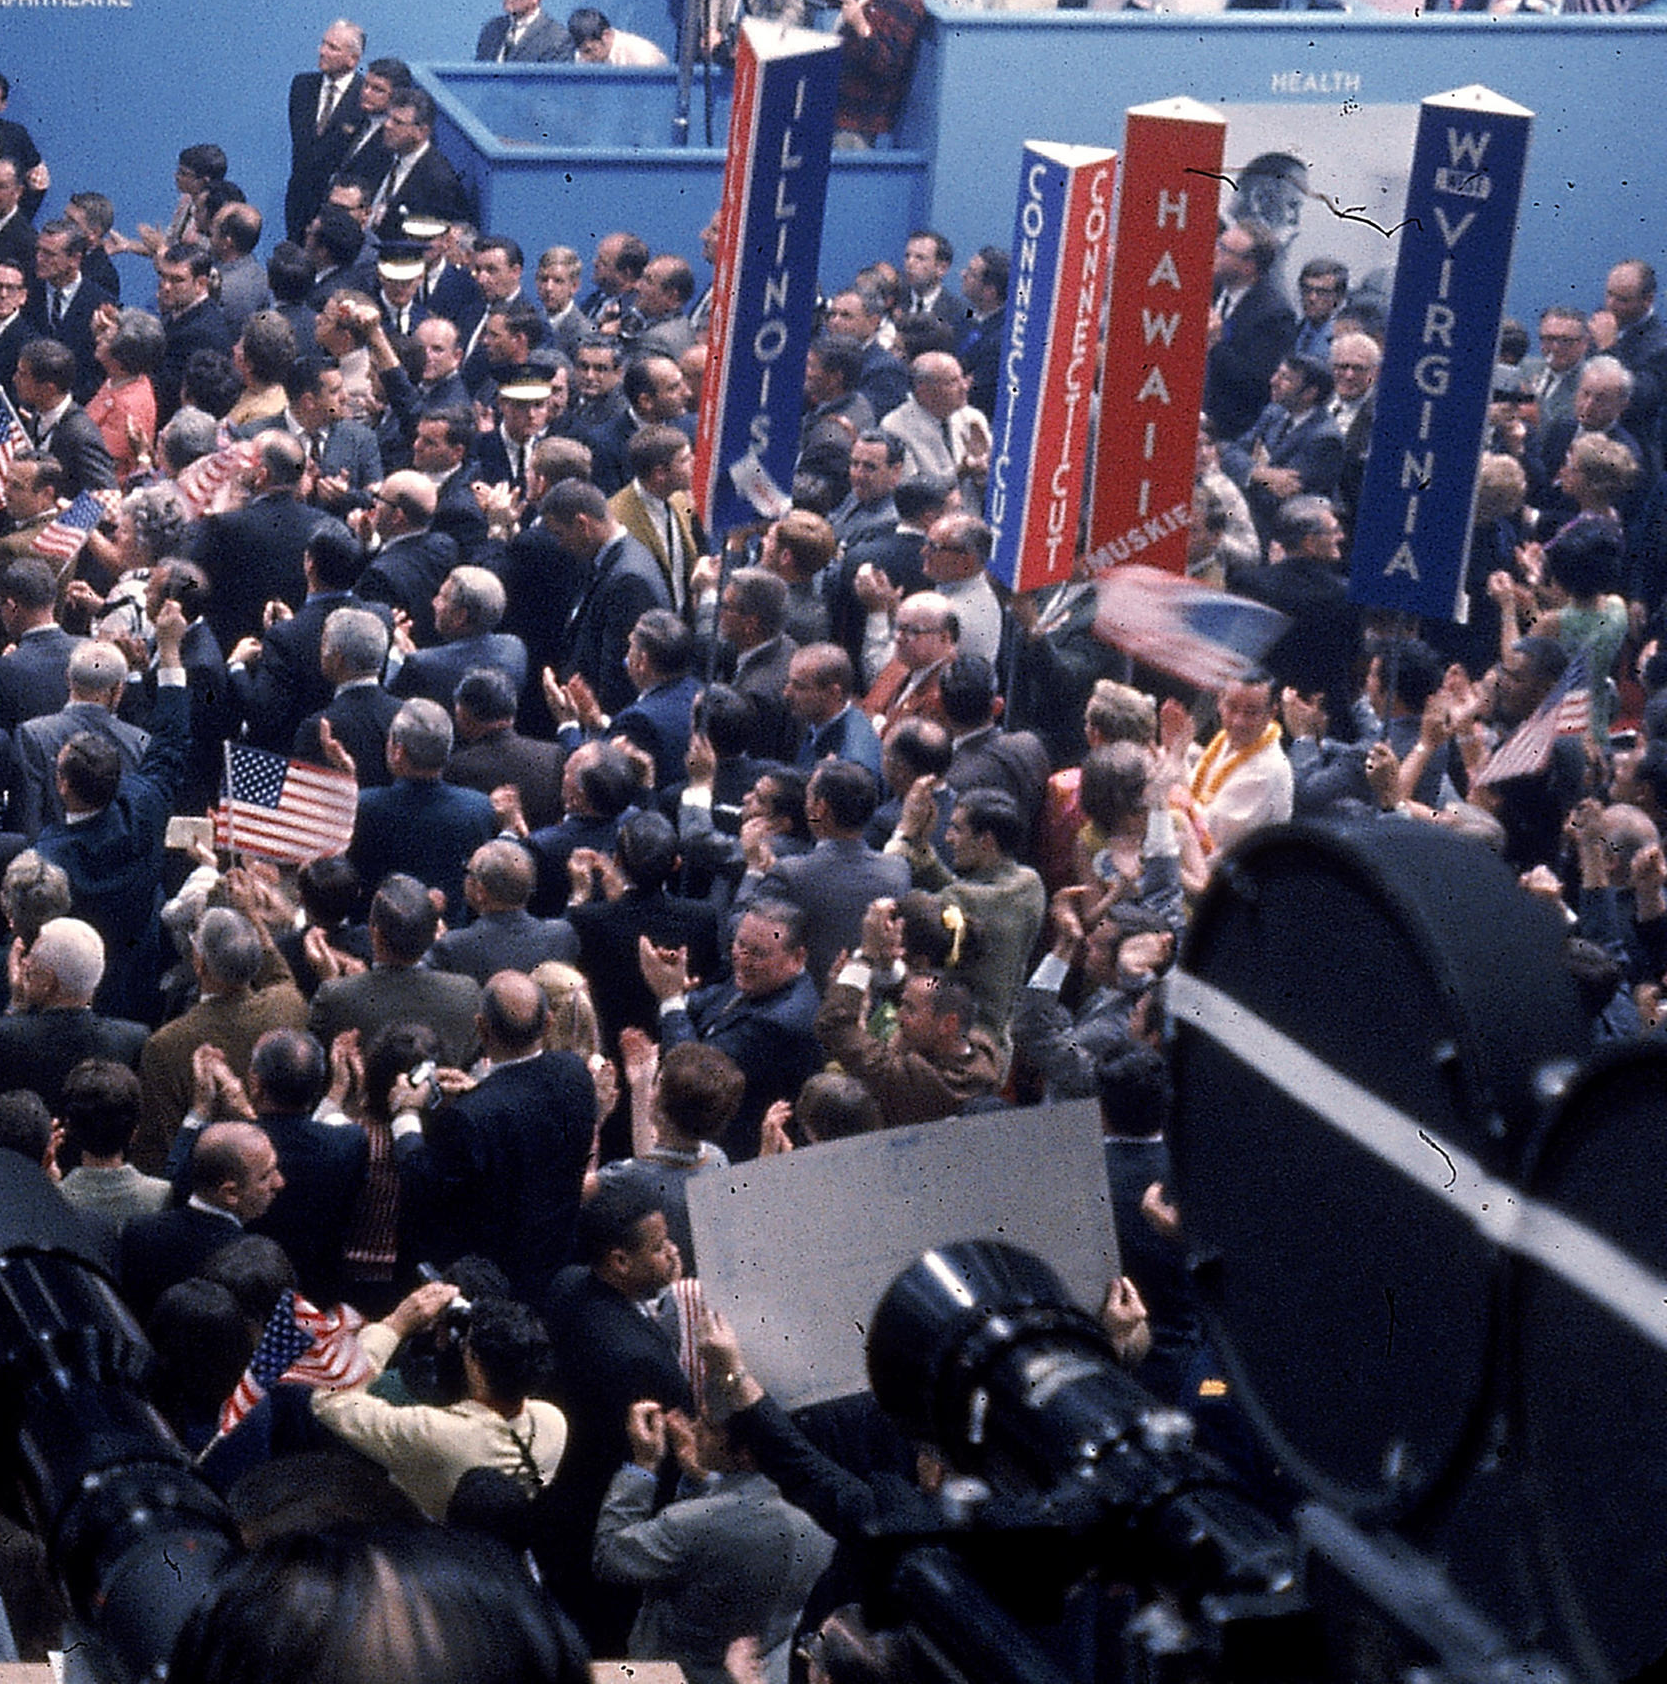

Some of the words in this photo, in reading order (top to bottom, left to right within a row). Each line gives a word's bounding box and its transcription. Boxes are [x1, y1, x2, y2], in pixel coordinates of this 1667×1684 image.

[750, 78, 806, 449] ILLINOIS
[1271, 71, 1360, 93] HEALTH
[990, 164, 1047, 562] CONNECTICUT
[1046, 168, 1109, 572] CONNECTICUT
[1084, 502, 1193, 574] MUSKIE
[1137, 189, 1190, 518] HAWAII
[1383, 207, 1475, 582] VIRGINIA
